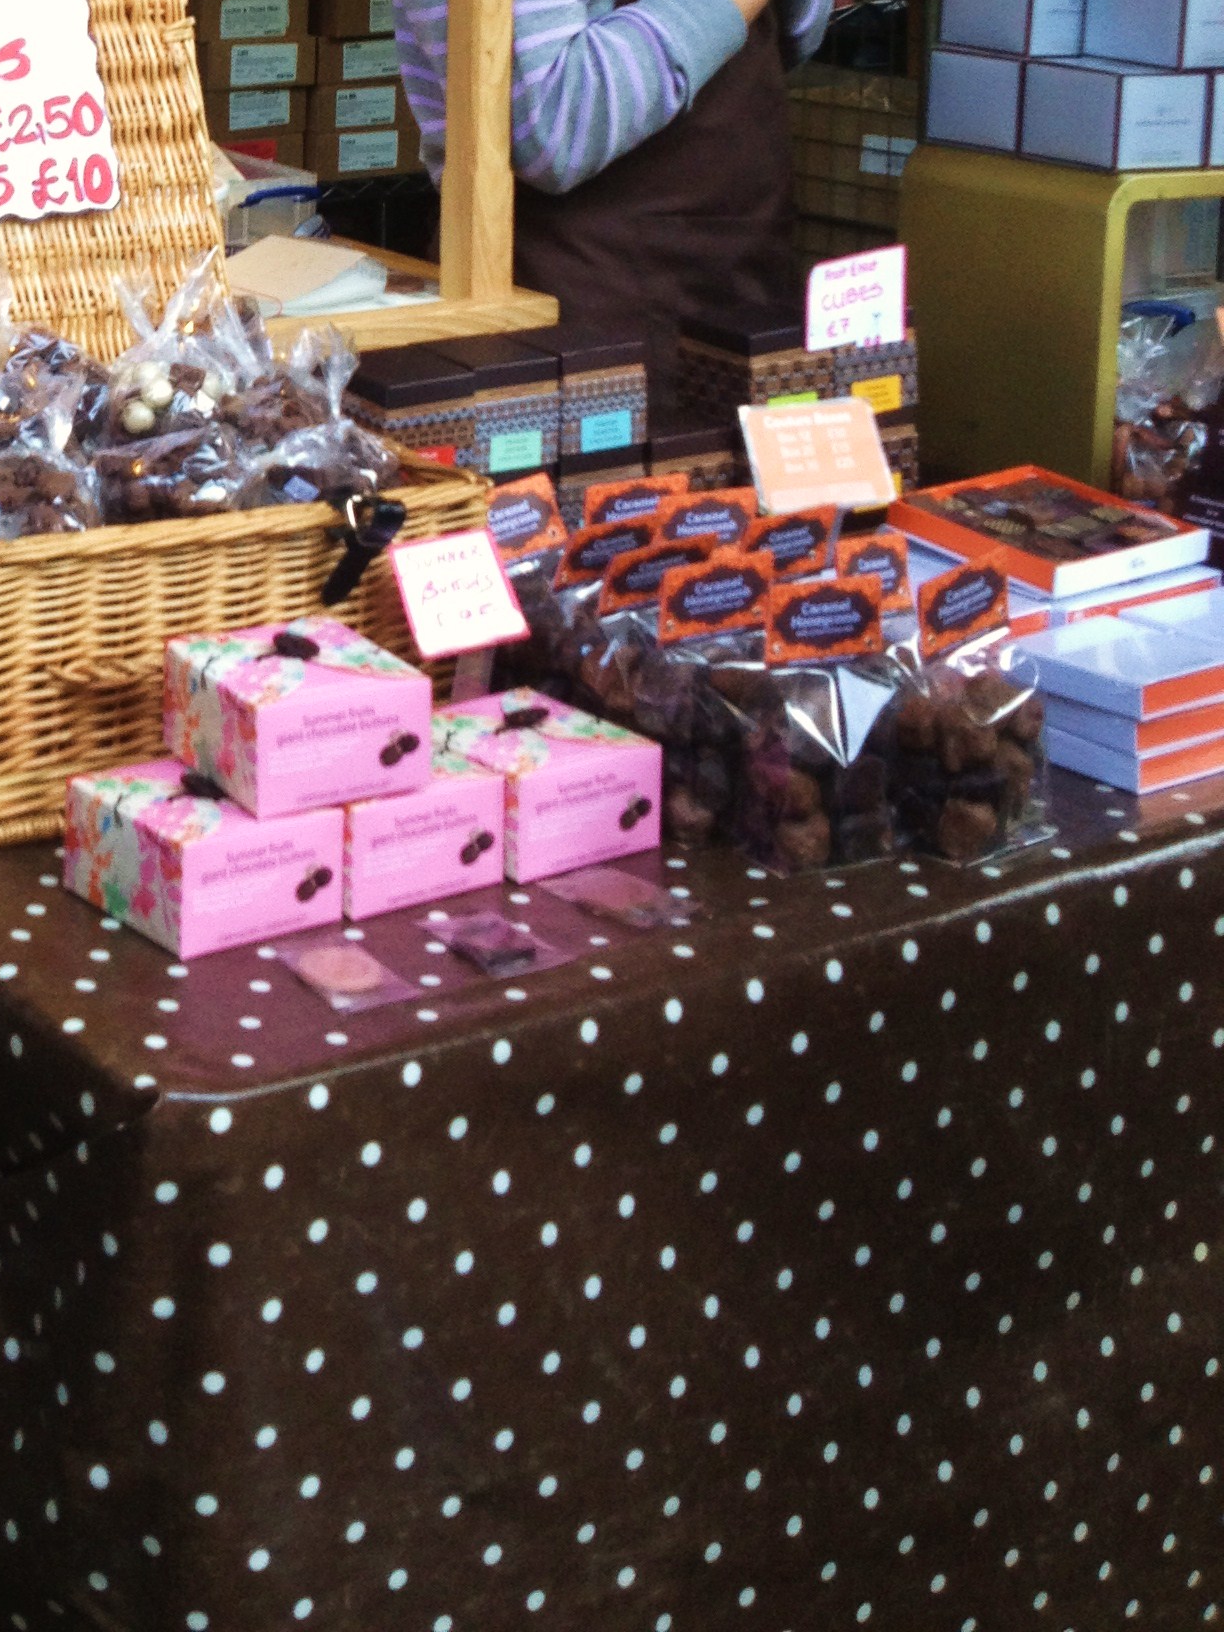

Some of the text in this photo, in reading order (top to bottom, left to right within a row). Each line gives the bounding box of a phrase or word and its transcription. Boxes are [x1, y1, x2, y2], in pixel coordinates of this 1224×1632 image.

[31, 153, 114, 210] £10
[821, 282, 884, 311] CUBES
[800, 597, 853, 617] Caramel
